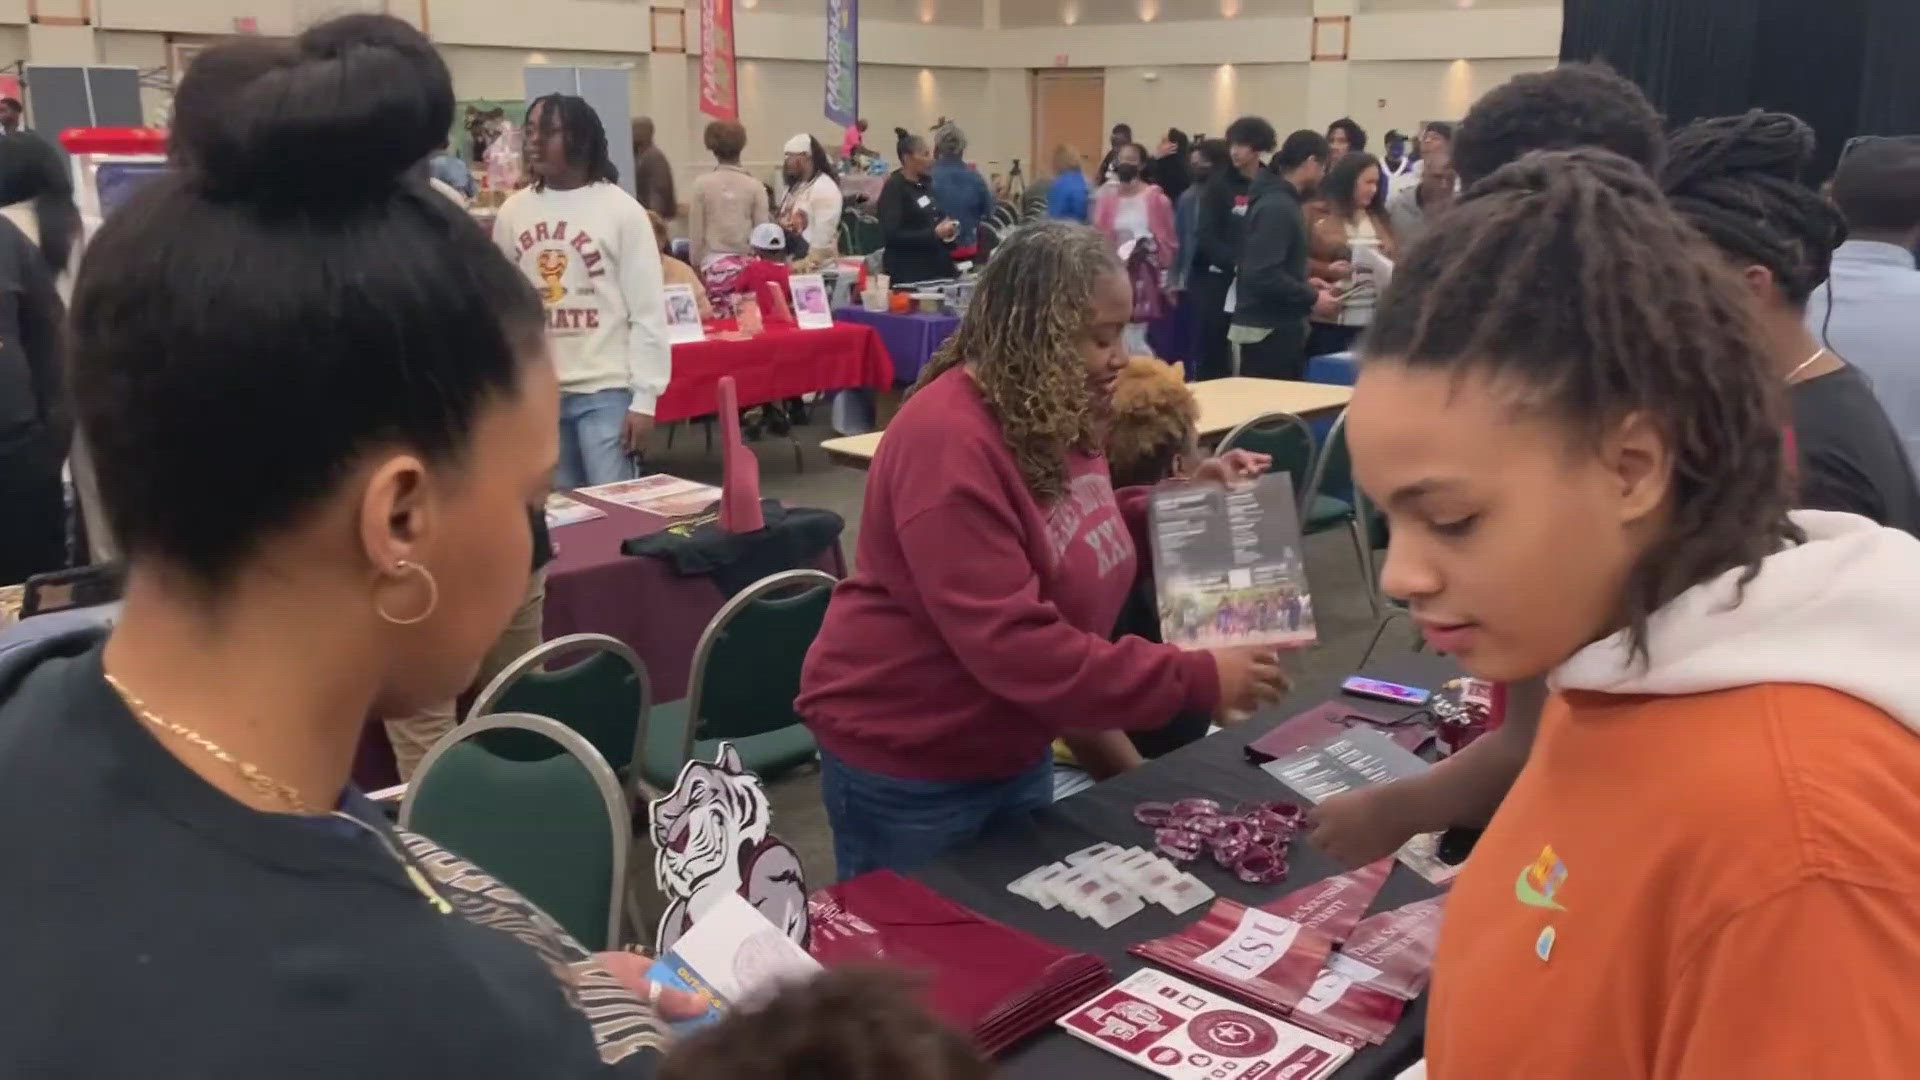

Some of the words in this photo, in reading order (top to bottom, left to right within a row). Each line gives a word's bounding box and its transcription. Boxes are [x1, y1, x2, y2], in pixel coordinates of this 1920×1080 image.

[515, 221, 568, 261] BRA
[570, 231, 605, 278] KAI
[1210, 914, 1291, 971] TSU
